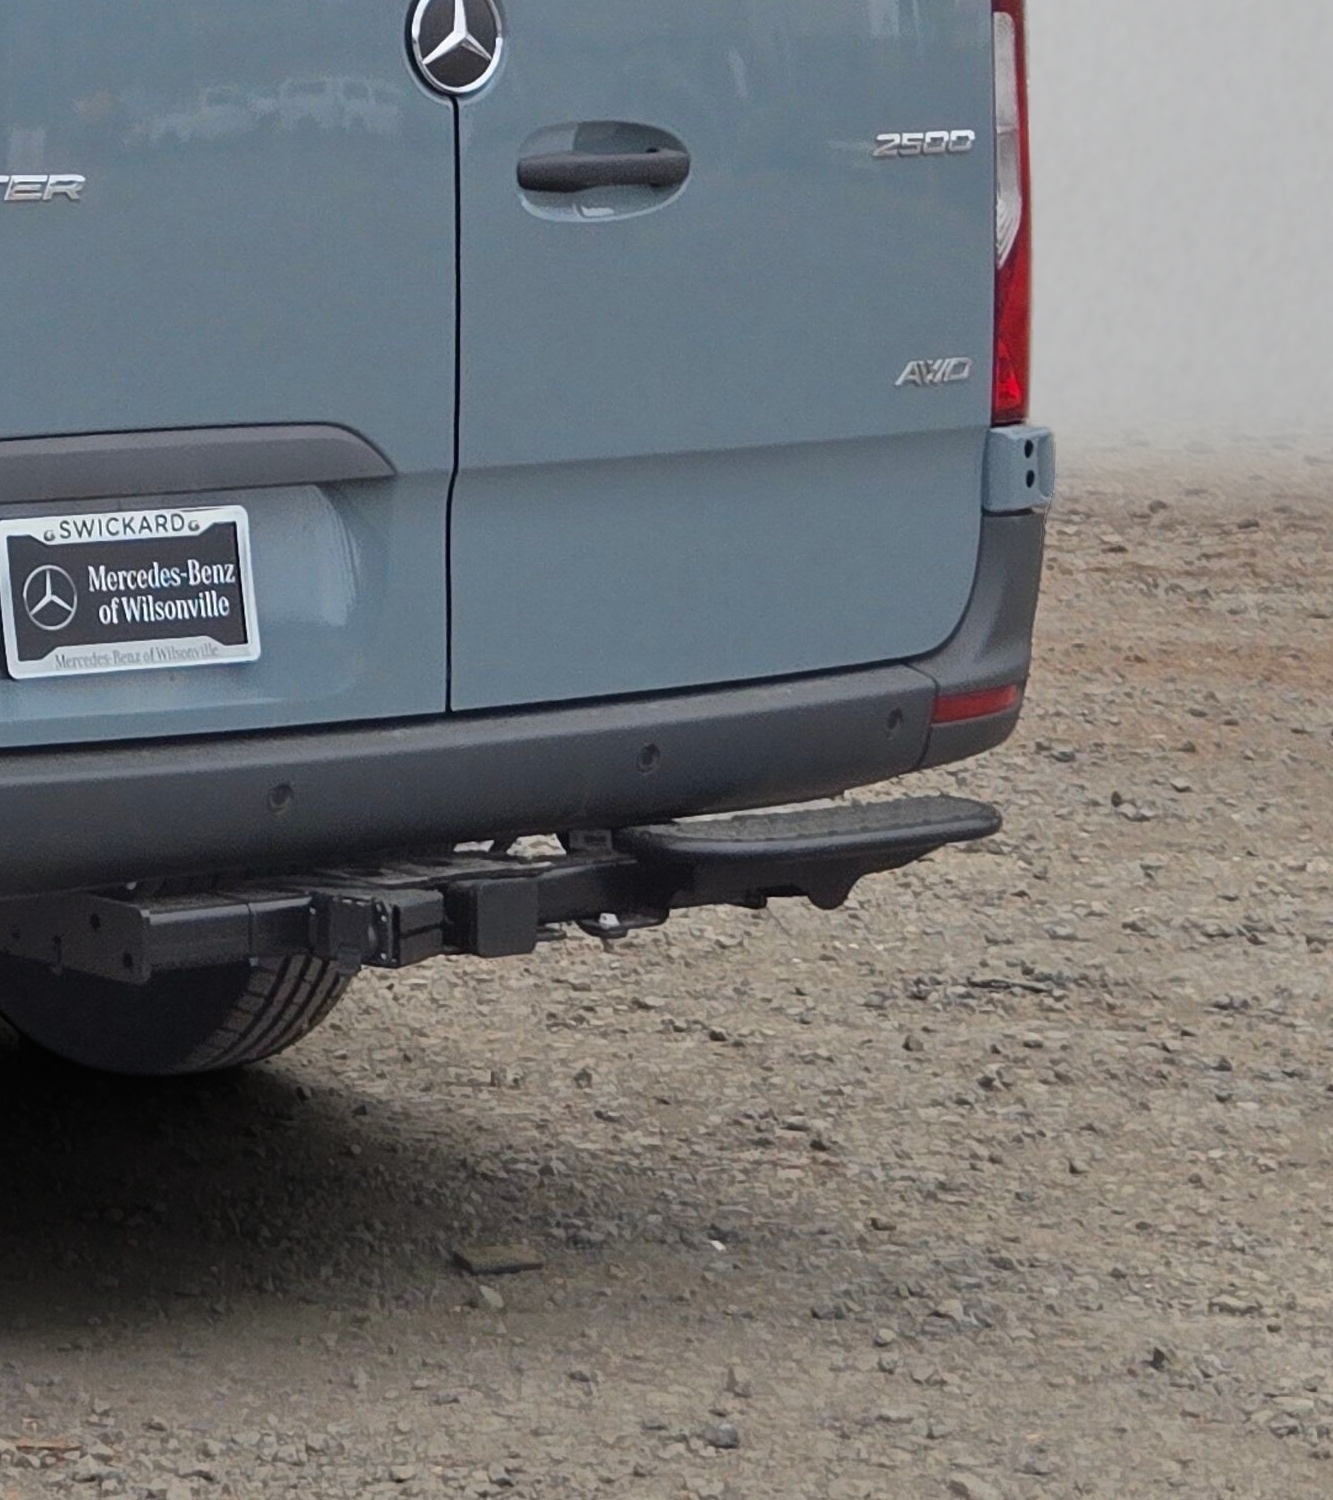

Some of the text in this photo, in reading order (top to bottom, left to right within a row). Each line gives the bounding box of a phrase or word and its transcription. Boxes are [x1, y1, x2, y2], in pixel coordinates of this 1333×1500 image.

[873, 129, 976, 156] 2500
[894, 357, 972, 386] AWD
[59, 513, 185, 539] SWICKARD
[88, 559, 235, 592] Mercedes-Benz
[98, 591, 230, 625] of Wilsonville
[54, 643, 219, 670] Mercedes-Benz of Wilsonville
